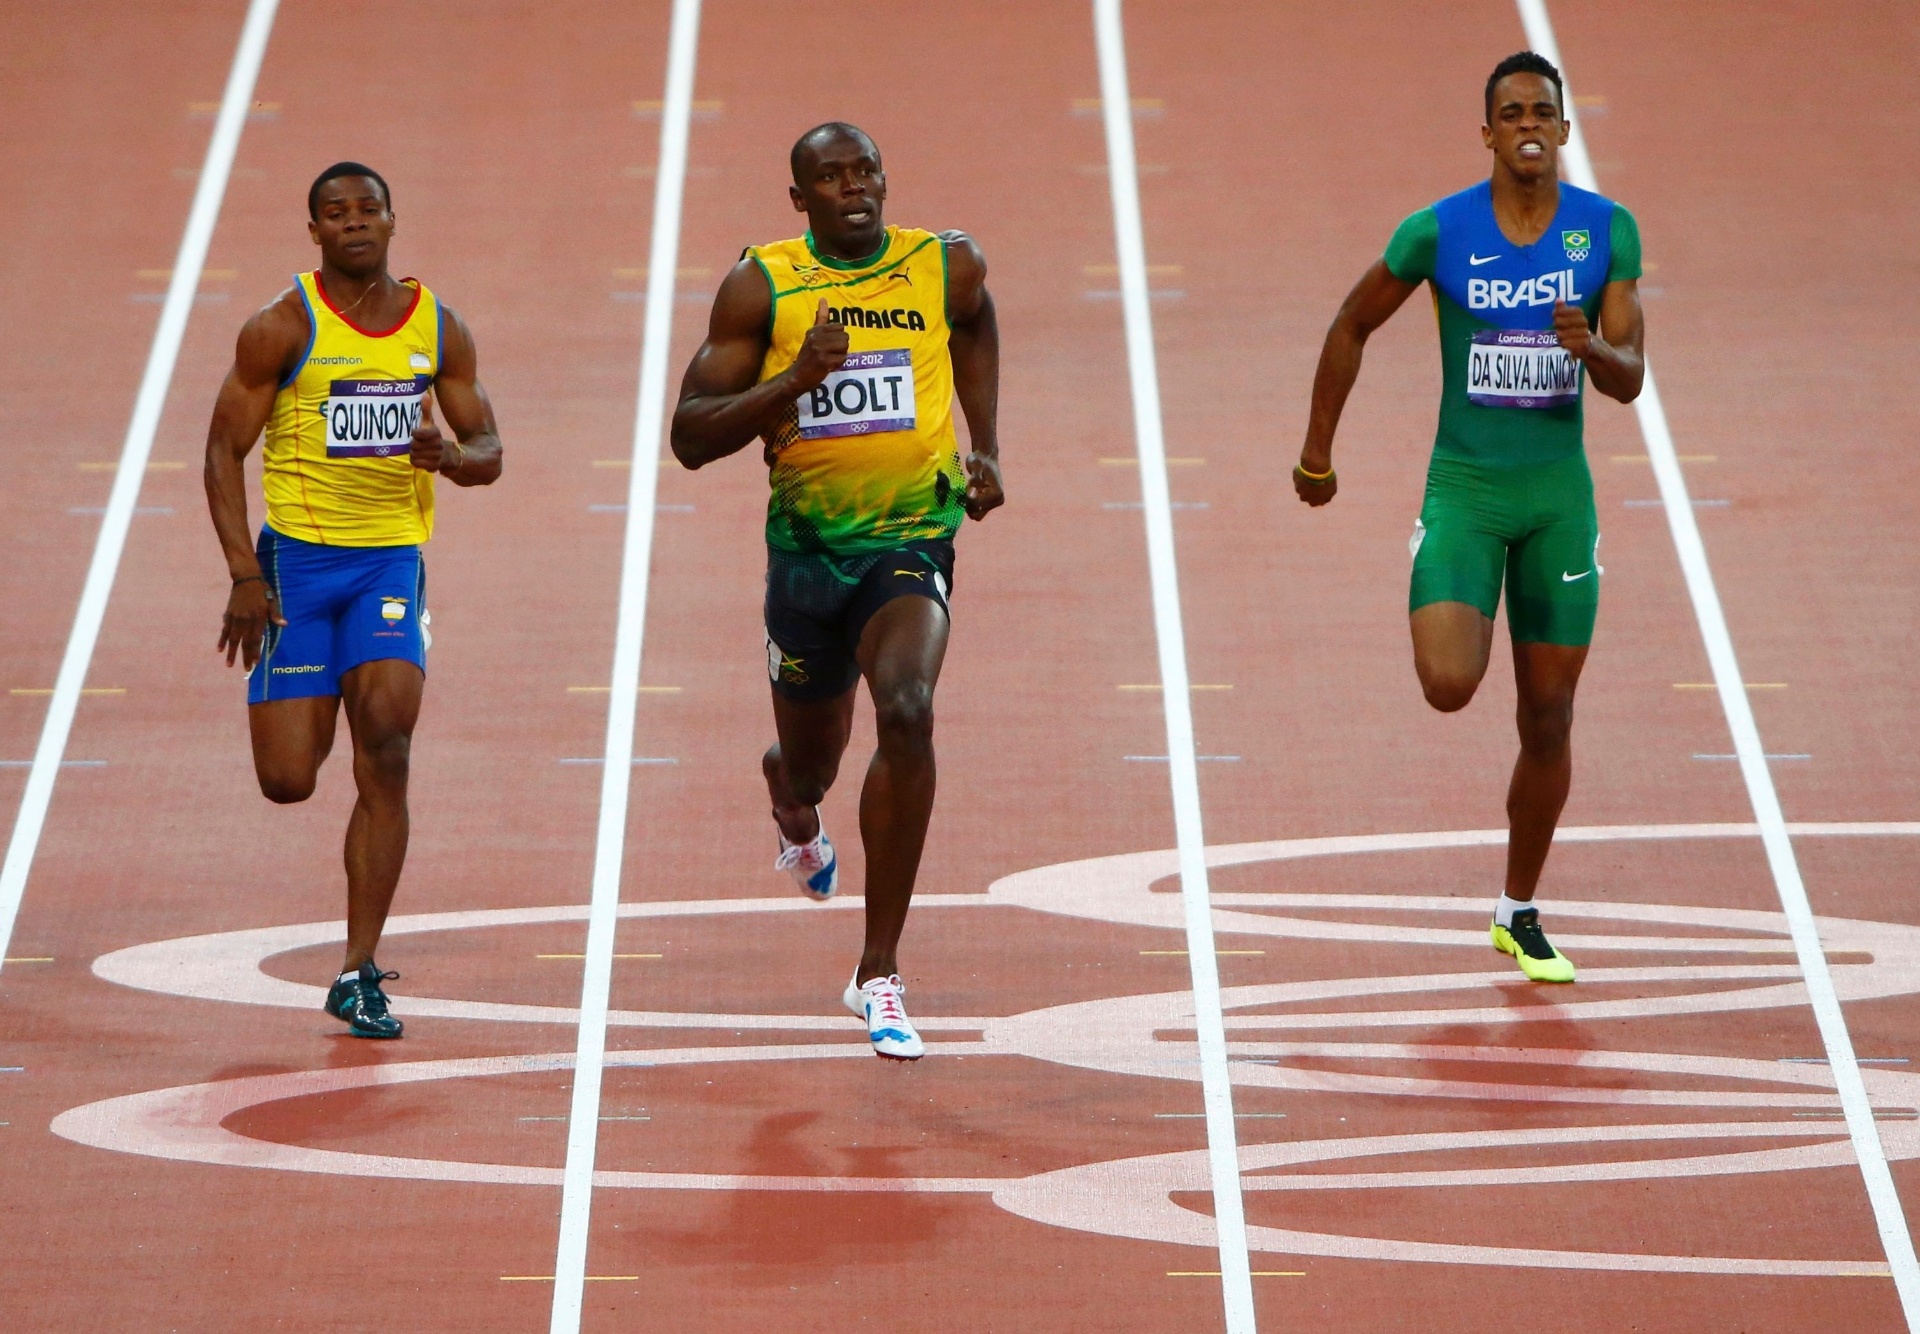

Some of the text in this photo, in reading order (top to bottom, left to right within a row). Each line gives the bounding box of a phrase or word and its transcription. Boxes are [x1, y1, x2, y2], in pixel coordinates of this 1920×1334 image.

[1468, 269, 1582, 309] BRASIL
[827, 306, 926, 331] AMAICA
[1498, 333, 1558, 345] London 2012
[309, 356, 363, 365] marathon
[861, 354, 884, 365] 2012
[1472, 352, 1577, 390] DA SILVA JUNIOR
[356, 382, 416, 393] London 2012
[809, 376, 903, 418] BOLT
[332, 401, 422, 441] QUINON
